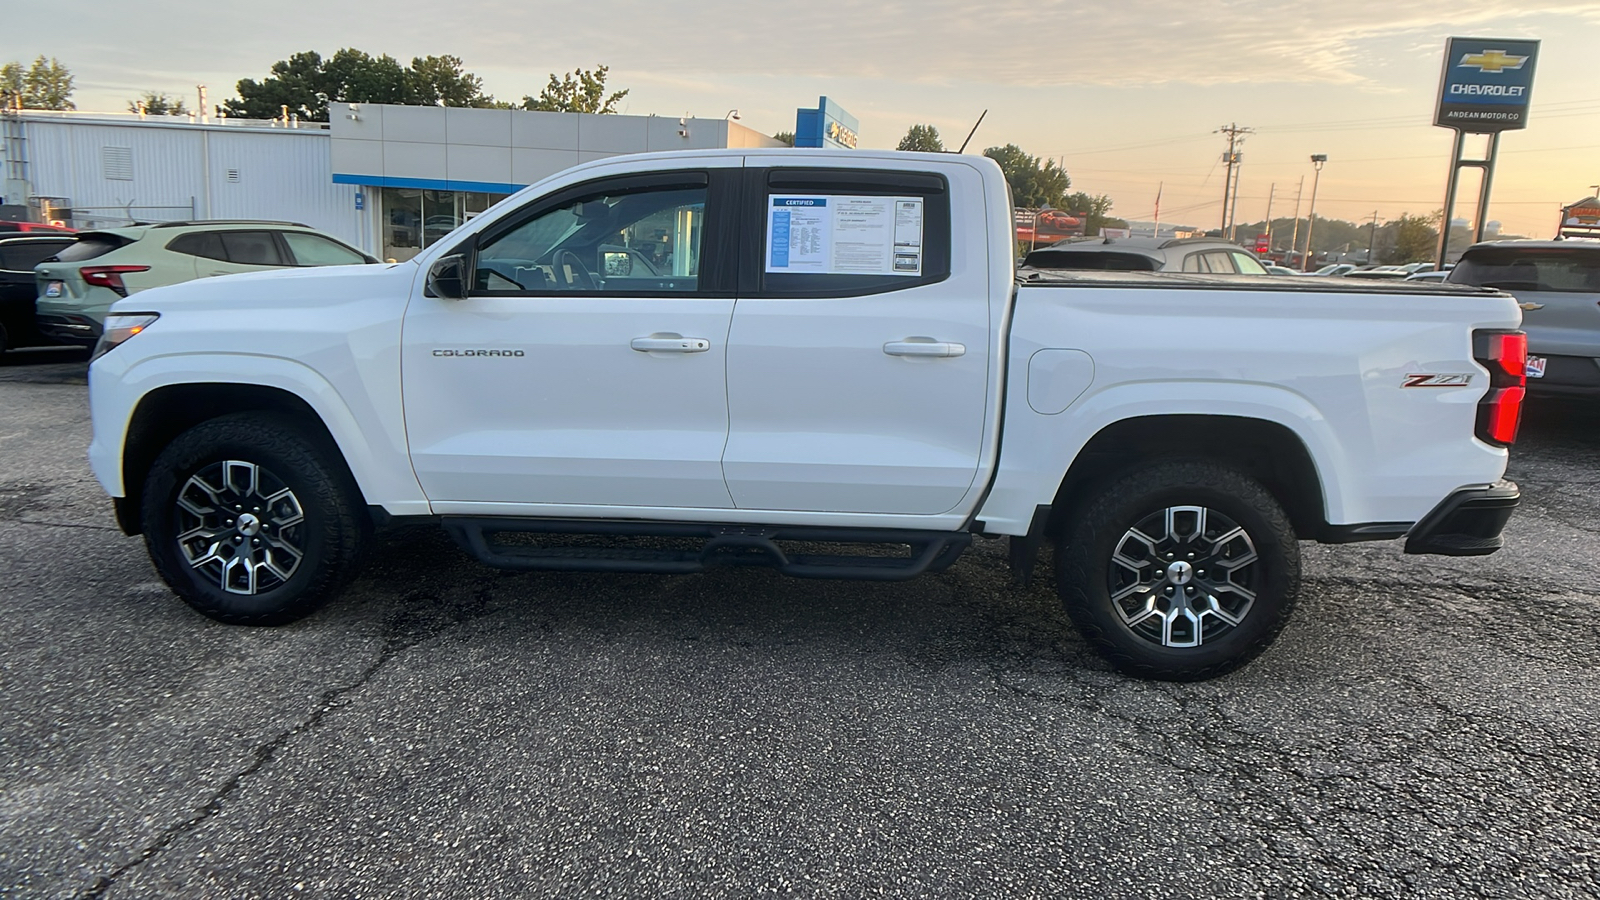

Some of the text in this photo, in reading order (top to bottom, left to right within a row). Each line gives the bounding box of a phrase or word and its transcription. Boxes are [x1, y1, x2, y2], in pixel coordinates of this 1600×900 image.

[1450, 84, 1525, 96] CHEVROLET
[1480, 112, 1507, 120] MOTOR
[1508, 112, 1519, 120] CO
[432, 349, 525, 357] COLORADO
[1400, 373, 1475, 388] Z71
